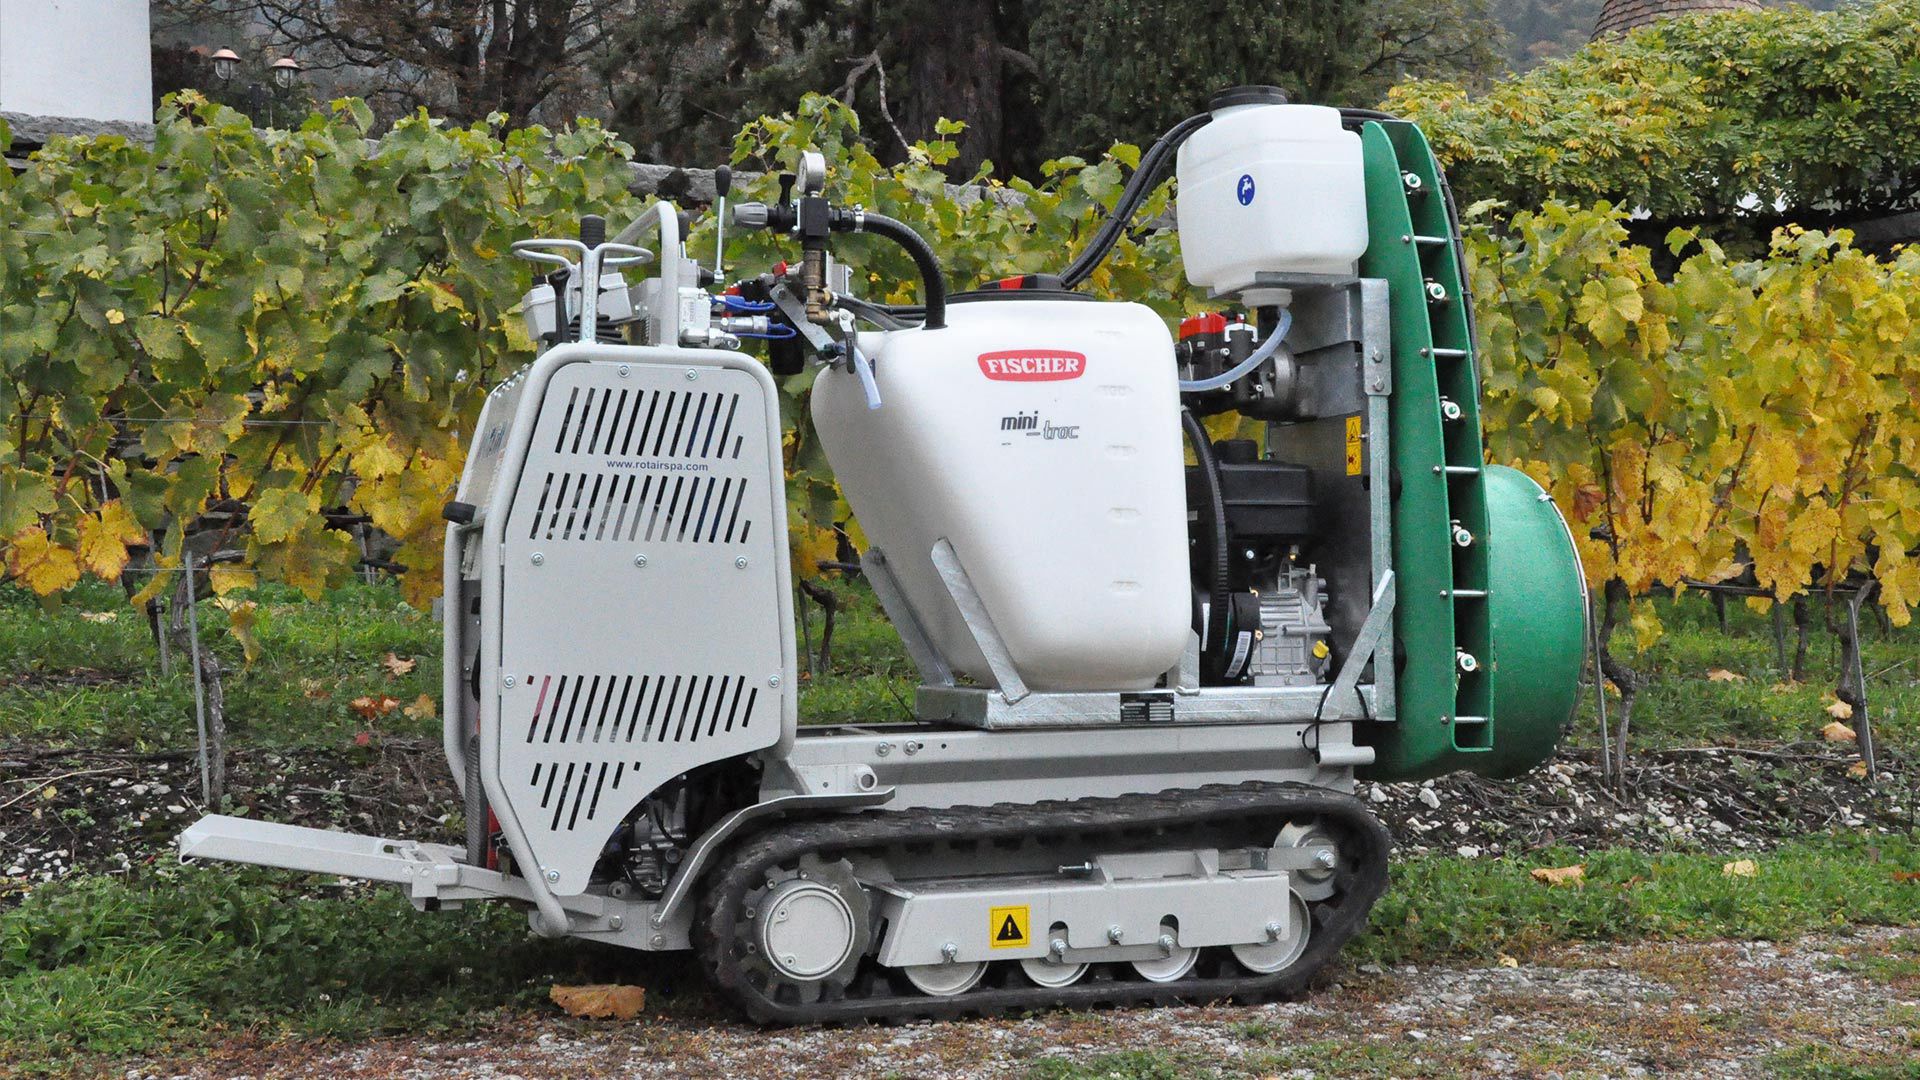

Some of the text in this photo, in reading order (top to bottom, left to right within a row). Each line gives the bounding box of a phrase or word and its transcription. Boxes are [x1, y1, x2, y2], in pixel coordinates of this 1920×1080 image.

[986, 357, 1080, 374] FISCHER
[1001, 410, 1039, 430] mini
[606, 460, 709, 472] www.rotairspa.com
